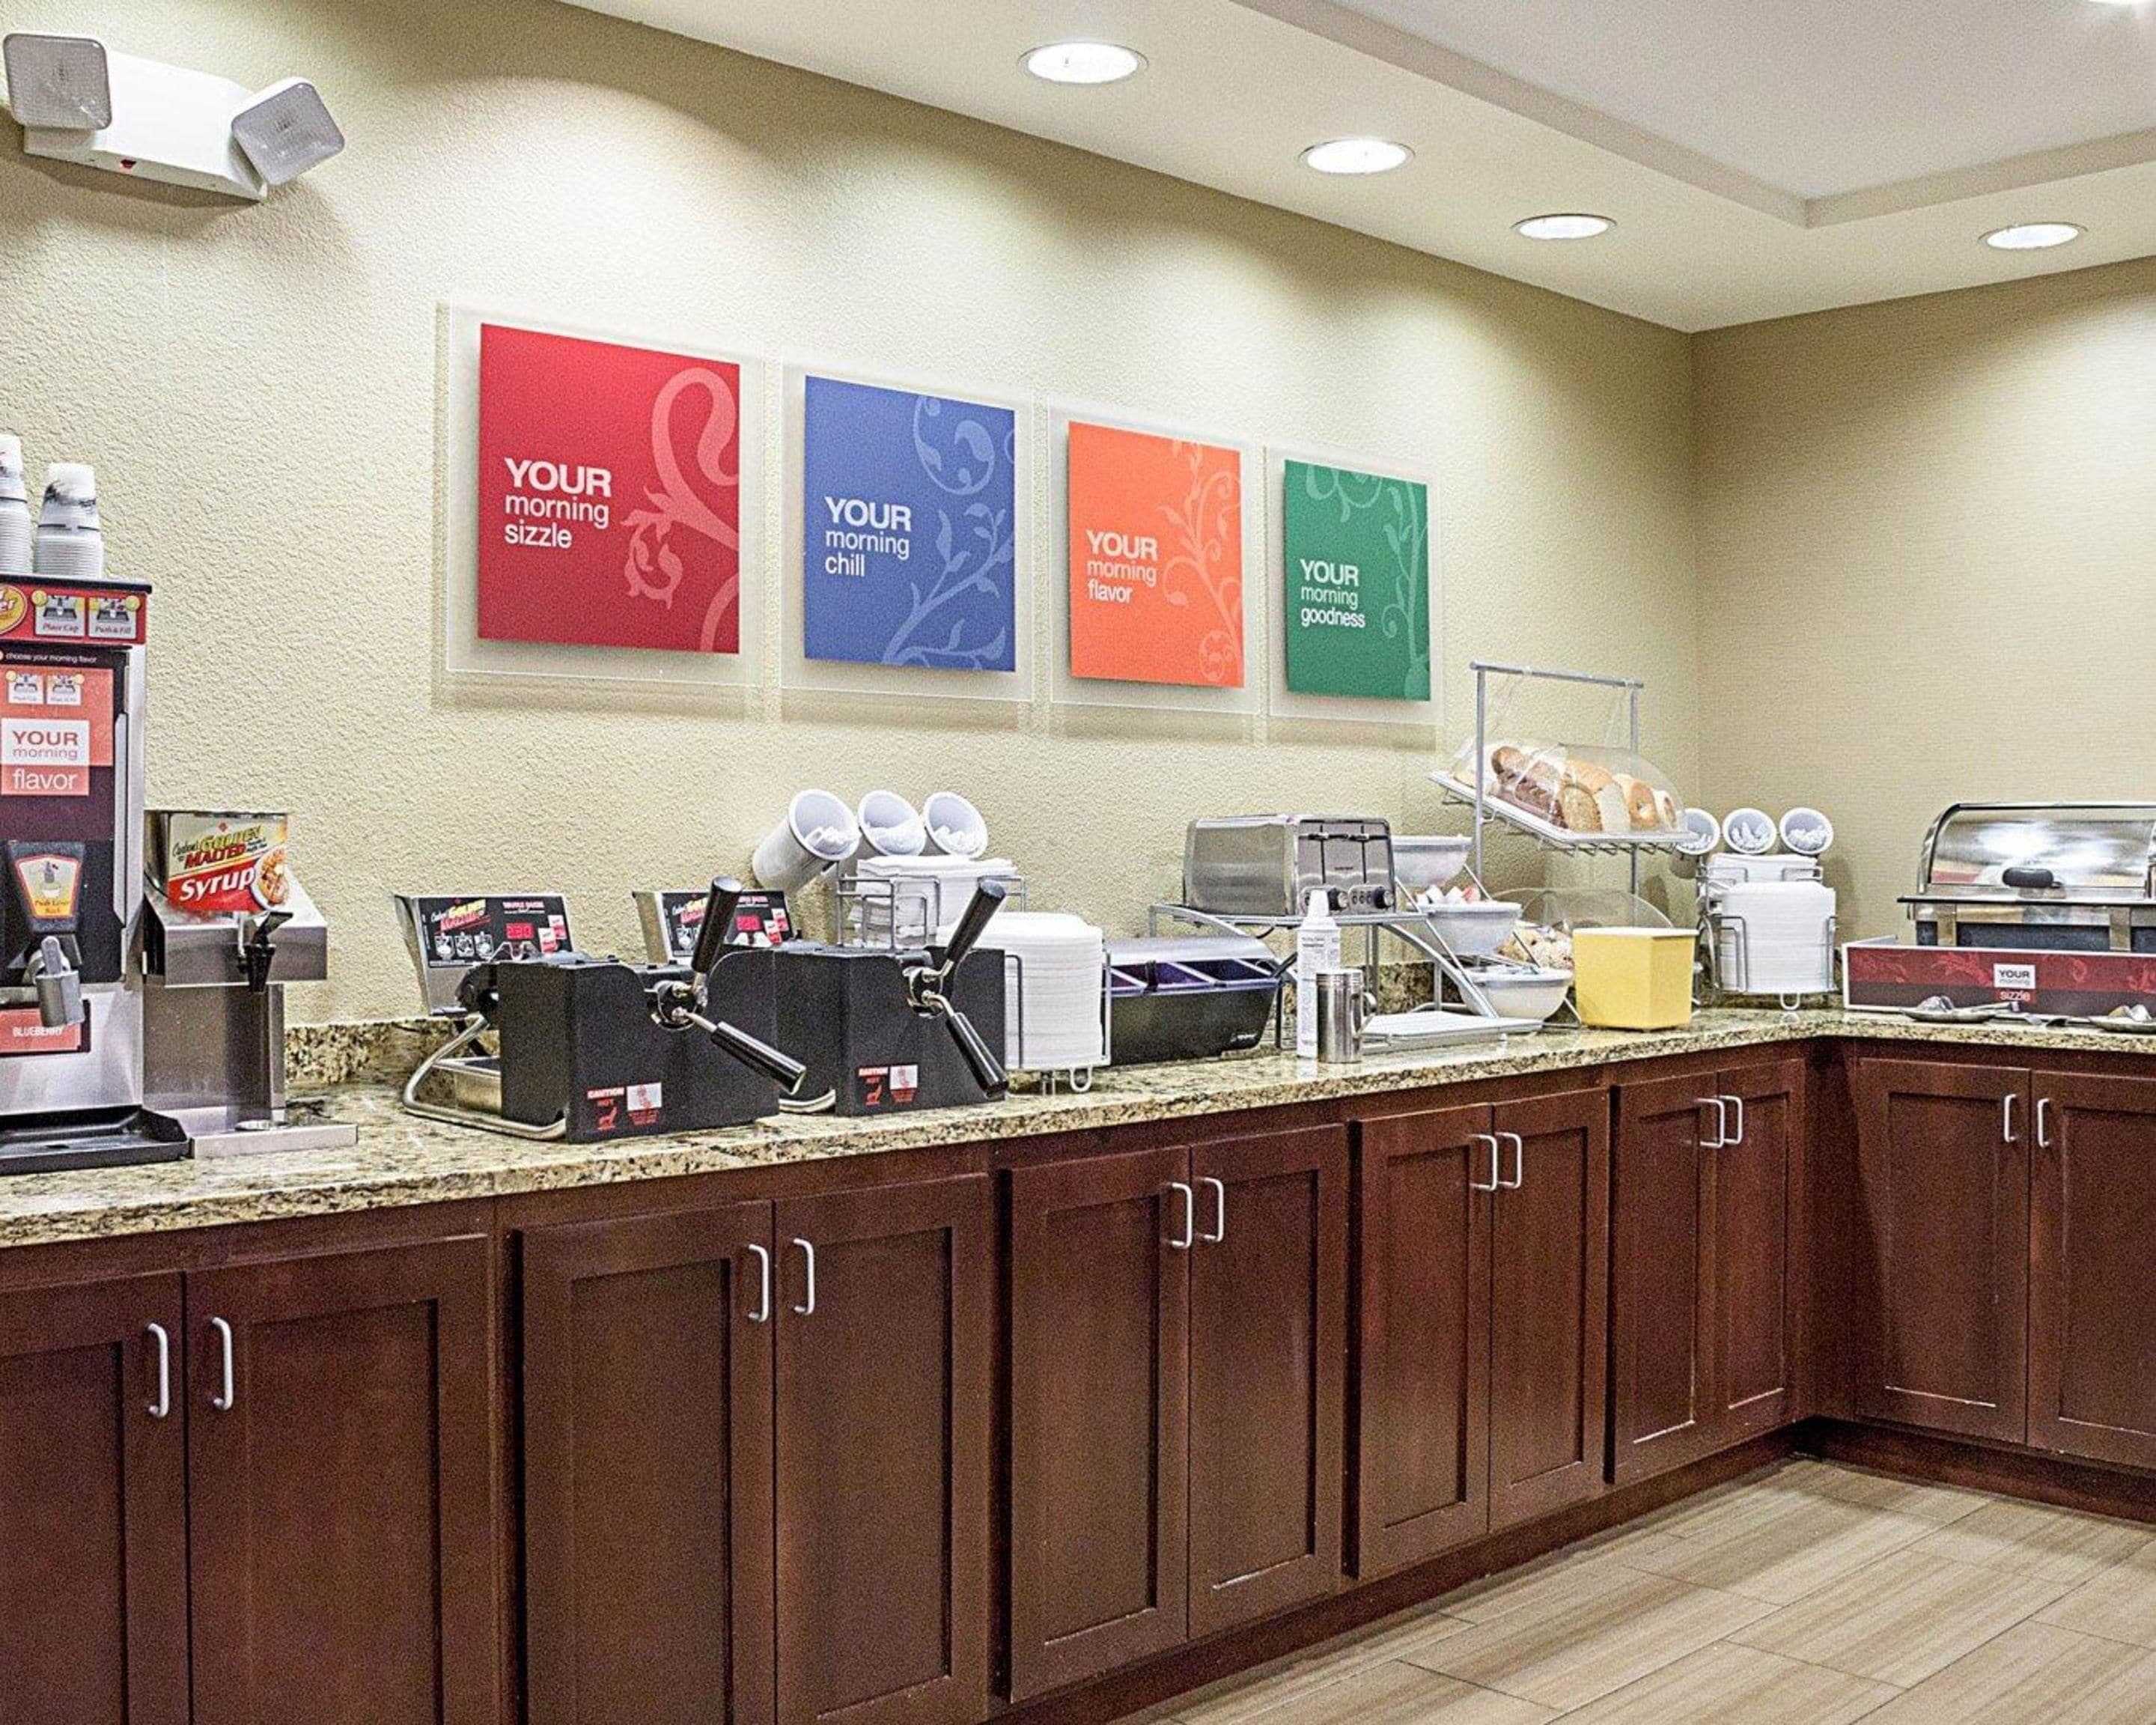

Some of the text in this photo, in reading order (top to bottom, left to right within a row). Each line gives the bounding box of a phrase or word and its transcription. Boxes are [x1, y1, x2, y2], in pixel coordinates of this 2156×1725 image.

[504, 457, 612, 498] YOUR
[505, 495, 609, 529] morning
[824, 496, 912, 532] YOUR
[505, 518, 572, 549] sizzle
[825, 530, 910, 561] morning
[1086, 529, 1158, 562] YOUR
[825, 551, 865, 577] chill
[1087, 559, 1157, 588] morning
[1300, 558, 1359, 587] YOUR
[1087, 578, 1133, 603] flavor
[1301, 586, 1358, 610] morning
[1301, 606, 1365, 628] goodness
[49, 654, 78, 664] morning
[79, 655, 97, 663] flavor
[12, 731, 79, 746] YOUR
[12, 747, 78, 761] morning
[12, 767, 79, 791] flavor
[179, 866, 255, 901] Syrup
[2000, 970, 2030, 979] YOUR
[2000, 990, 2031, 1002] sizzle
